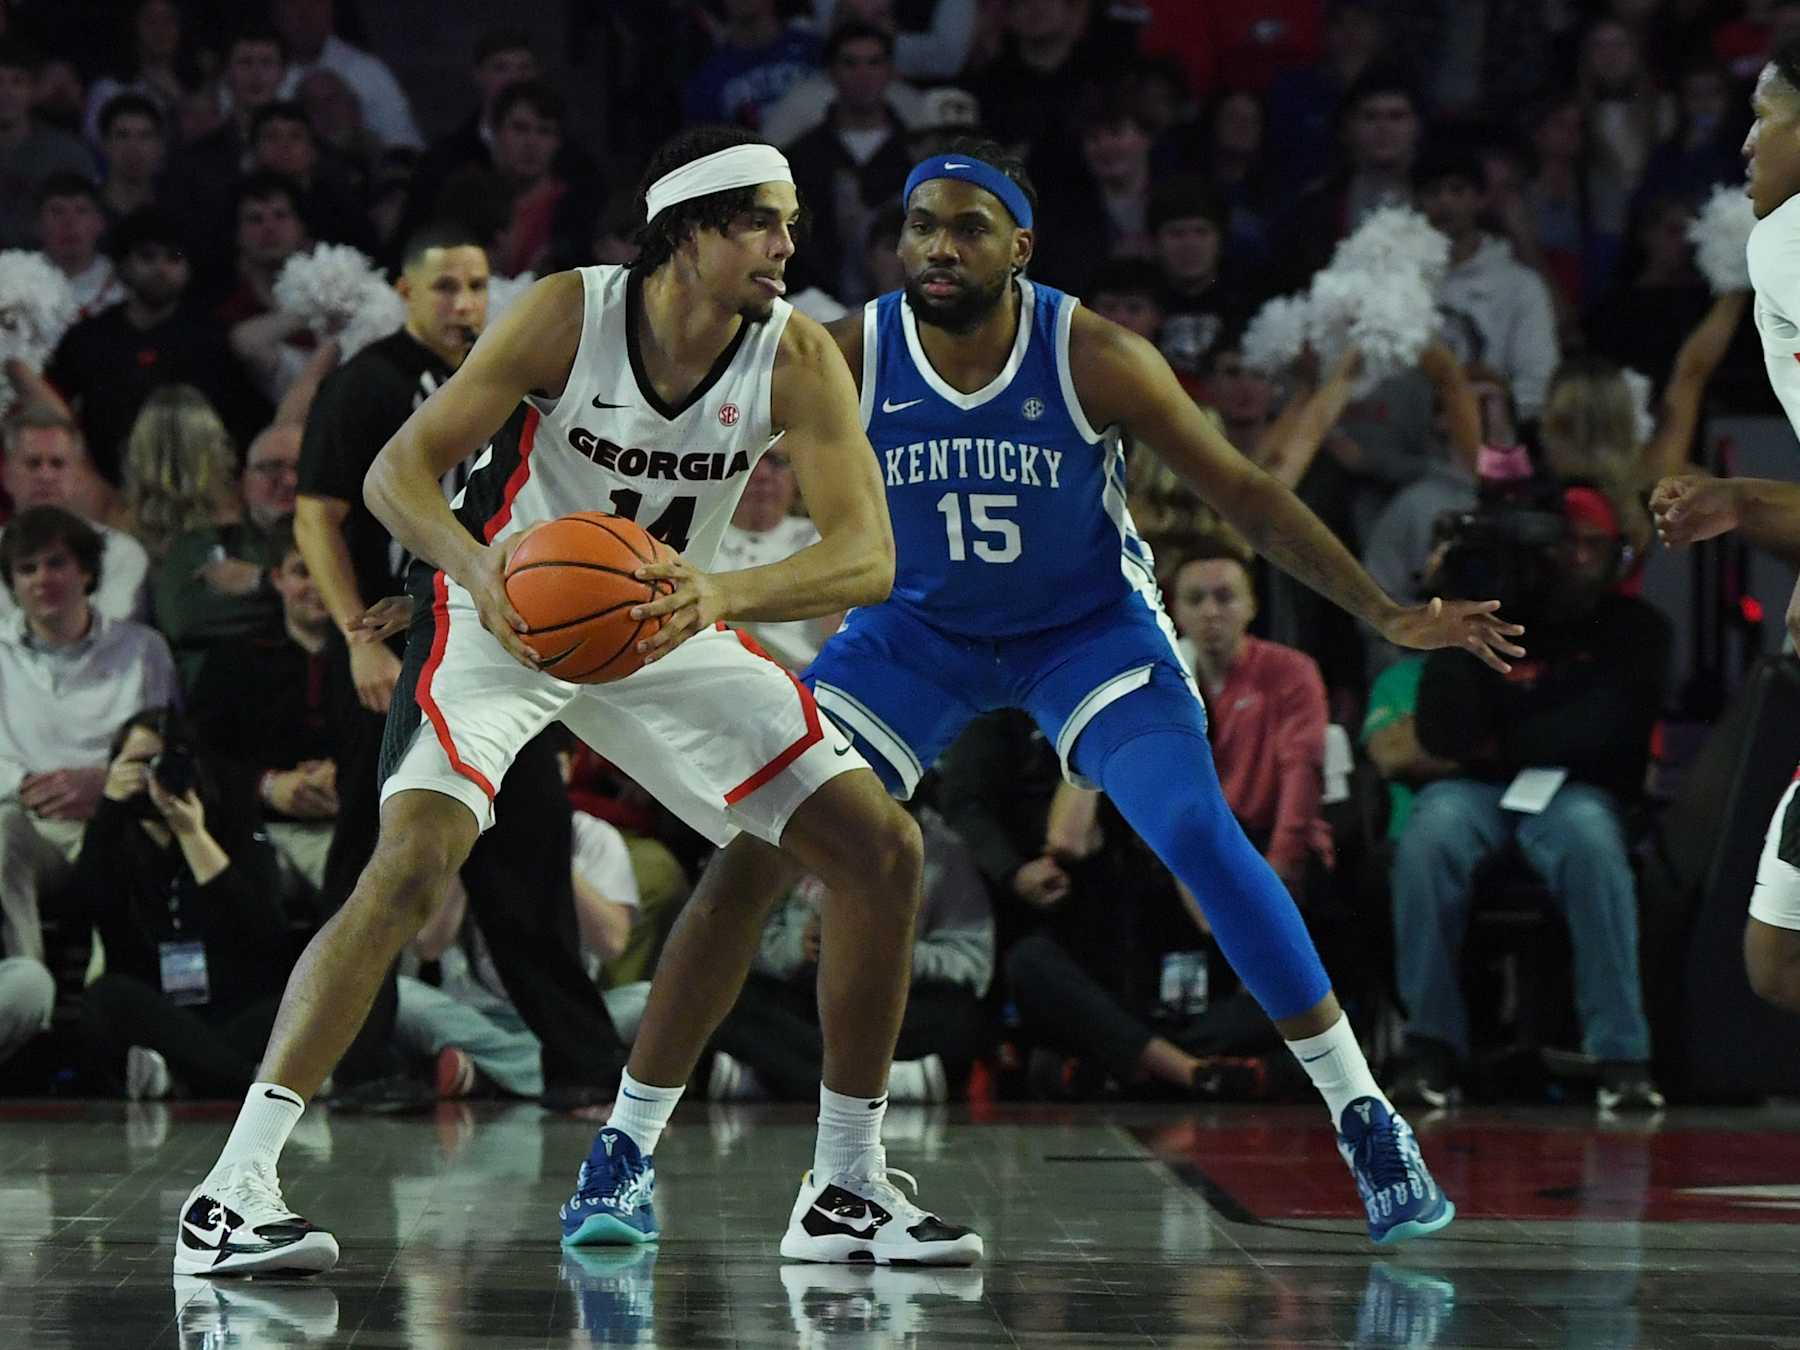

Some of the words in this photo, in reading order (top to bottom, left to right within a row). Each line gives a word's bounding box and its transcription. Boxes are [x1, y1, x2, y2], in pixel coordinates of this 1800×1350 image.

[568, 427, 750, 481] GEORGIA
[885, 438, 1063, 488] KENTUCKY
[936, 492, 1022, 563] 15
